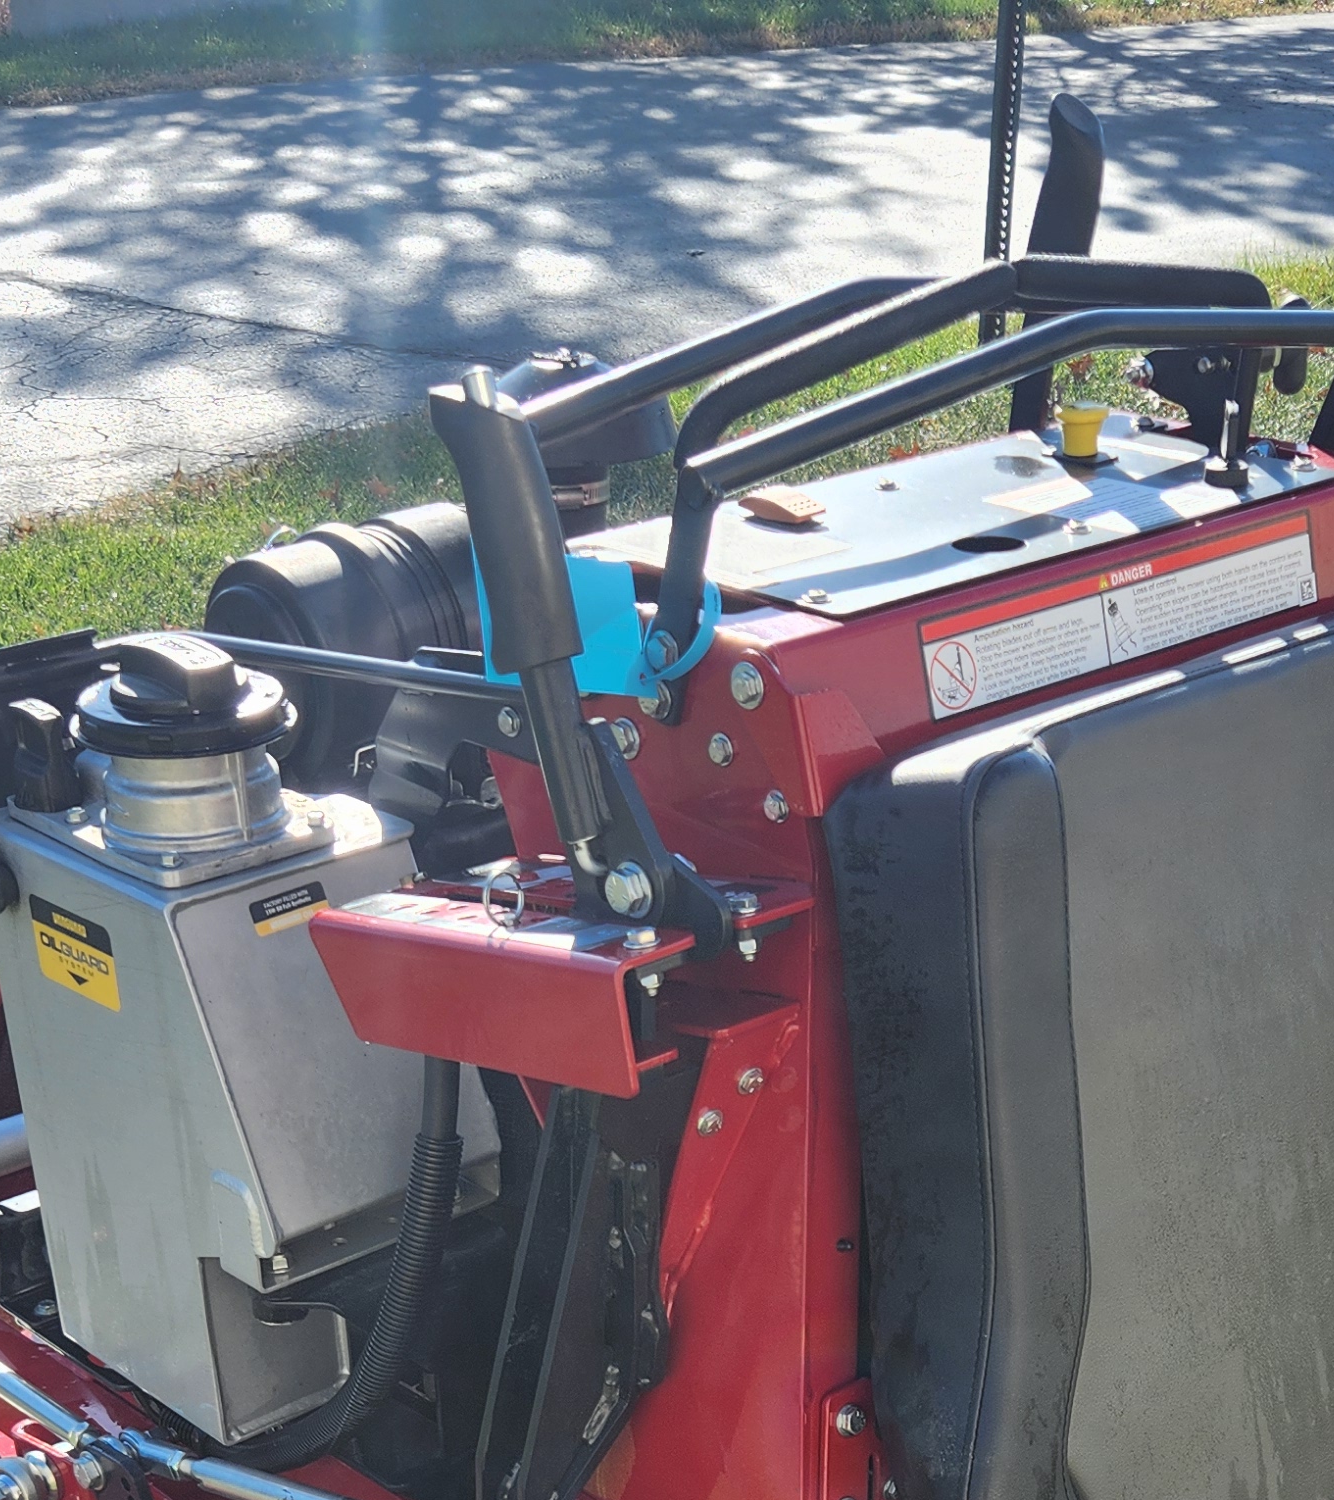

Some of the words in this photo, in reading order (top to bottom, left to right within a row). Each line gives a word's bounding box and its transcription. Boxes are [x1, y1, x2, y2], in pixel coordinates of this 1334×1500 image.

[1111, 564, 1152, 585] DANGER
[1132, 586, 1147, 595] Loss
[1148, 582, 1154, 591] of
[1156, 577, 1176, 588] control
[1134, 595, 1153, 605] Always
[1155, 588, 1175, 600] operate
[1187, 580, 1204, 588] mower
[1206, 575, 1220, 585] using
[1221, 570, 1232, 579] both
[1234, 566, 1250, 574] hands
[1269, 555, 1285, 565] control
[1287, 550, 1303, 559] levers.
[974, 627, 1010, 642] Amputation
[1012, 619, 1034, 630] hazard
[975, 642, 1000, 654] Rotating
[1002, 636, 1022, 647] blades
[1023, 631, 1032, 641] cut
[1043, 625, 1057, 635] arms
[1059, 620, 1070, 630] and
[1071, 618, 1083, 626] legs.
[40, 932, 109, 974] OILGUARD
[59, 956, 94, 976] SYSTEM
